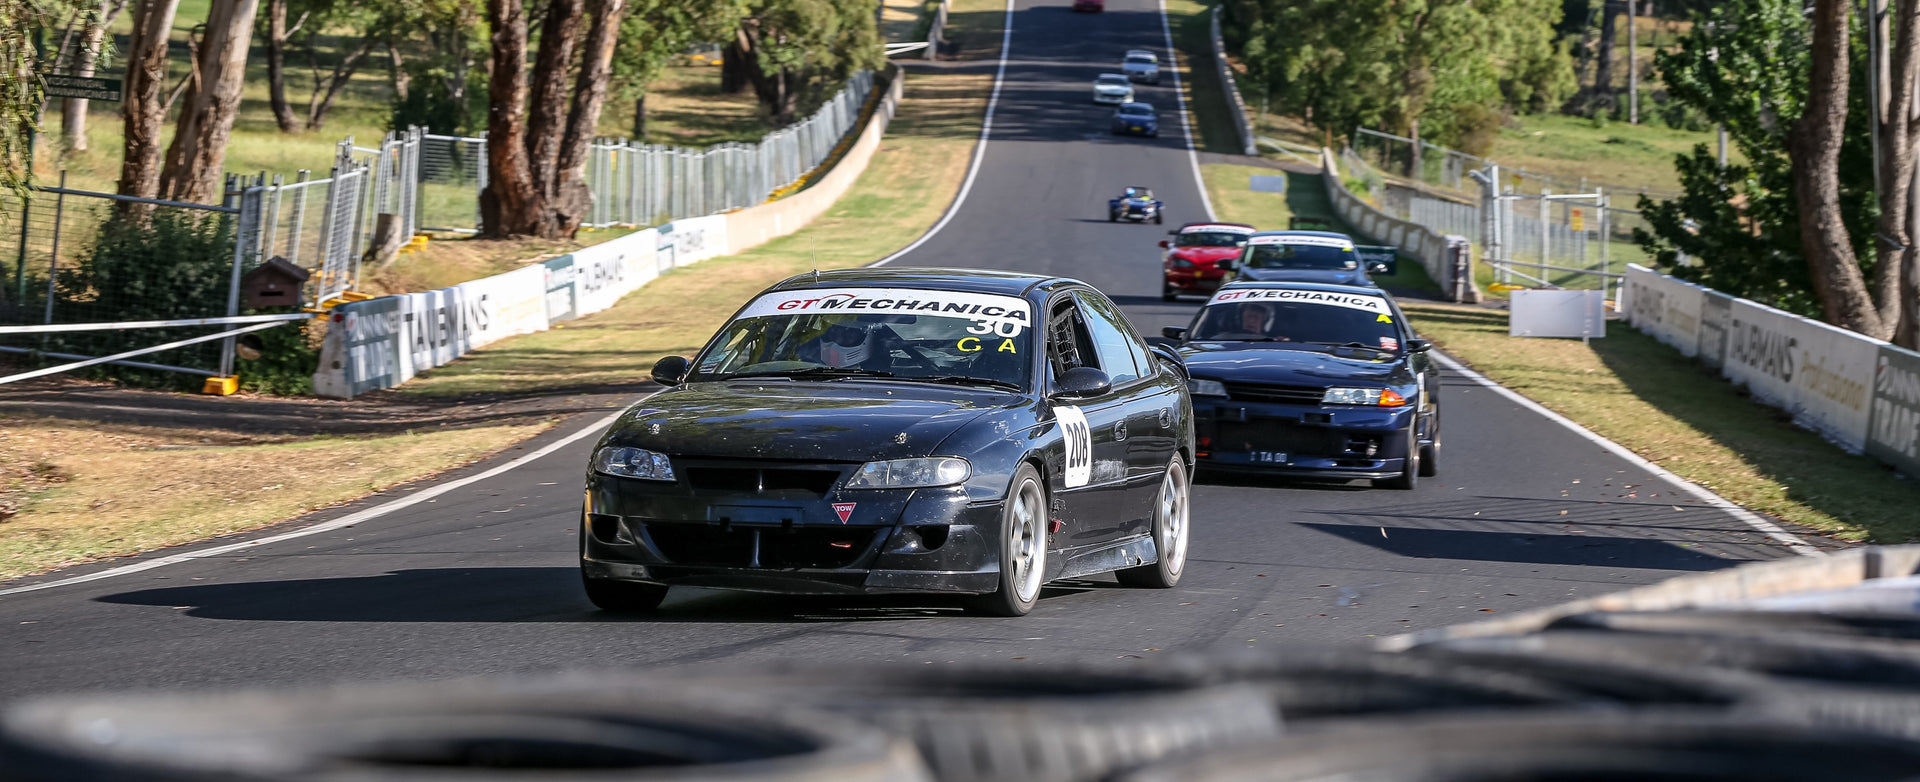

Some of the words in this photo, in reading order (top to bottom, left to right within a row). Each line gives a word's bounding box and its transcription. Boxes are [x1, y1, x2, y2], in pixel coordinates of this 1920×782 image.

[777, 299, 822, 311] GT
[821, 299, 1026, 321] MECHANICA
[1217, 291, 1248, 301] GT
[1246, 290, 1378, 309] MECHANICA
[966, 317, 1022, 338] 30
[998, 338, 1017, 354] A
[1066, 421, 1088, 468] 208
